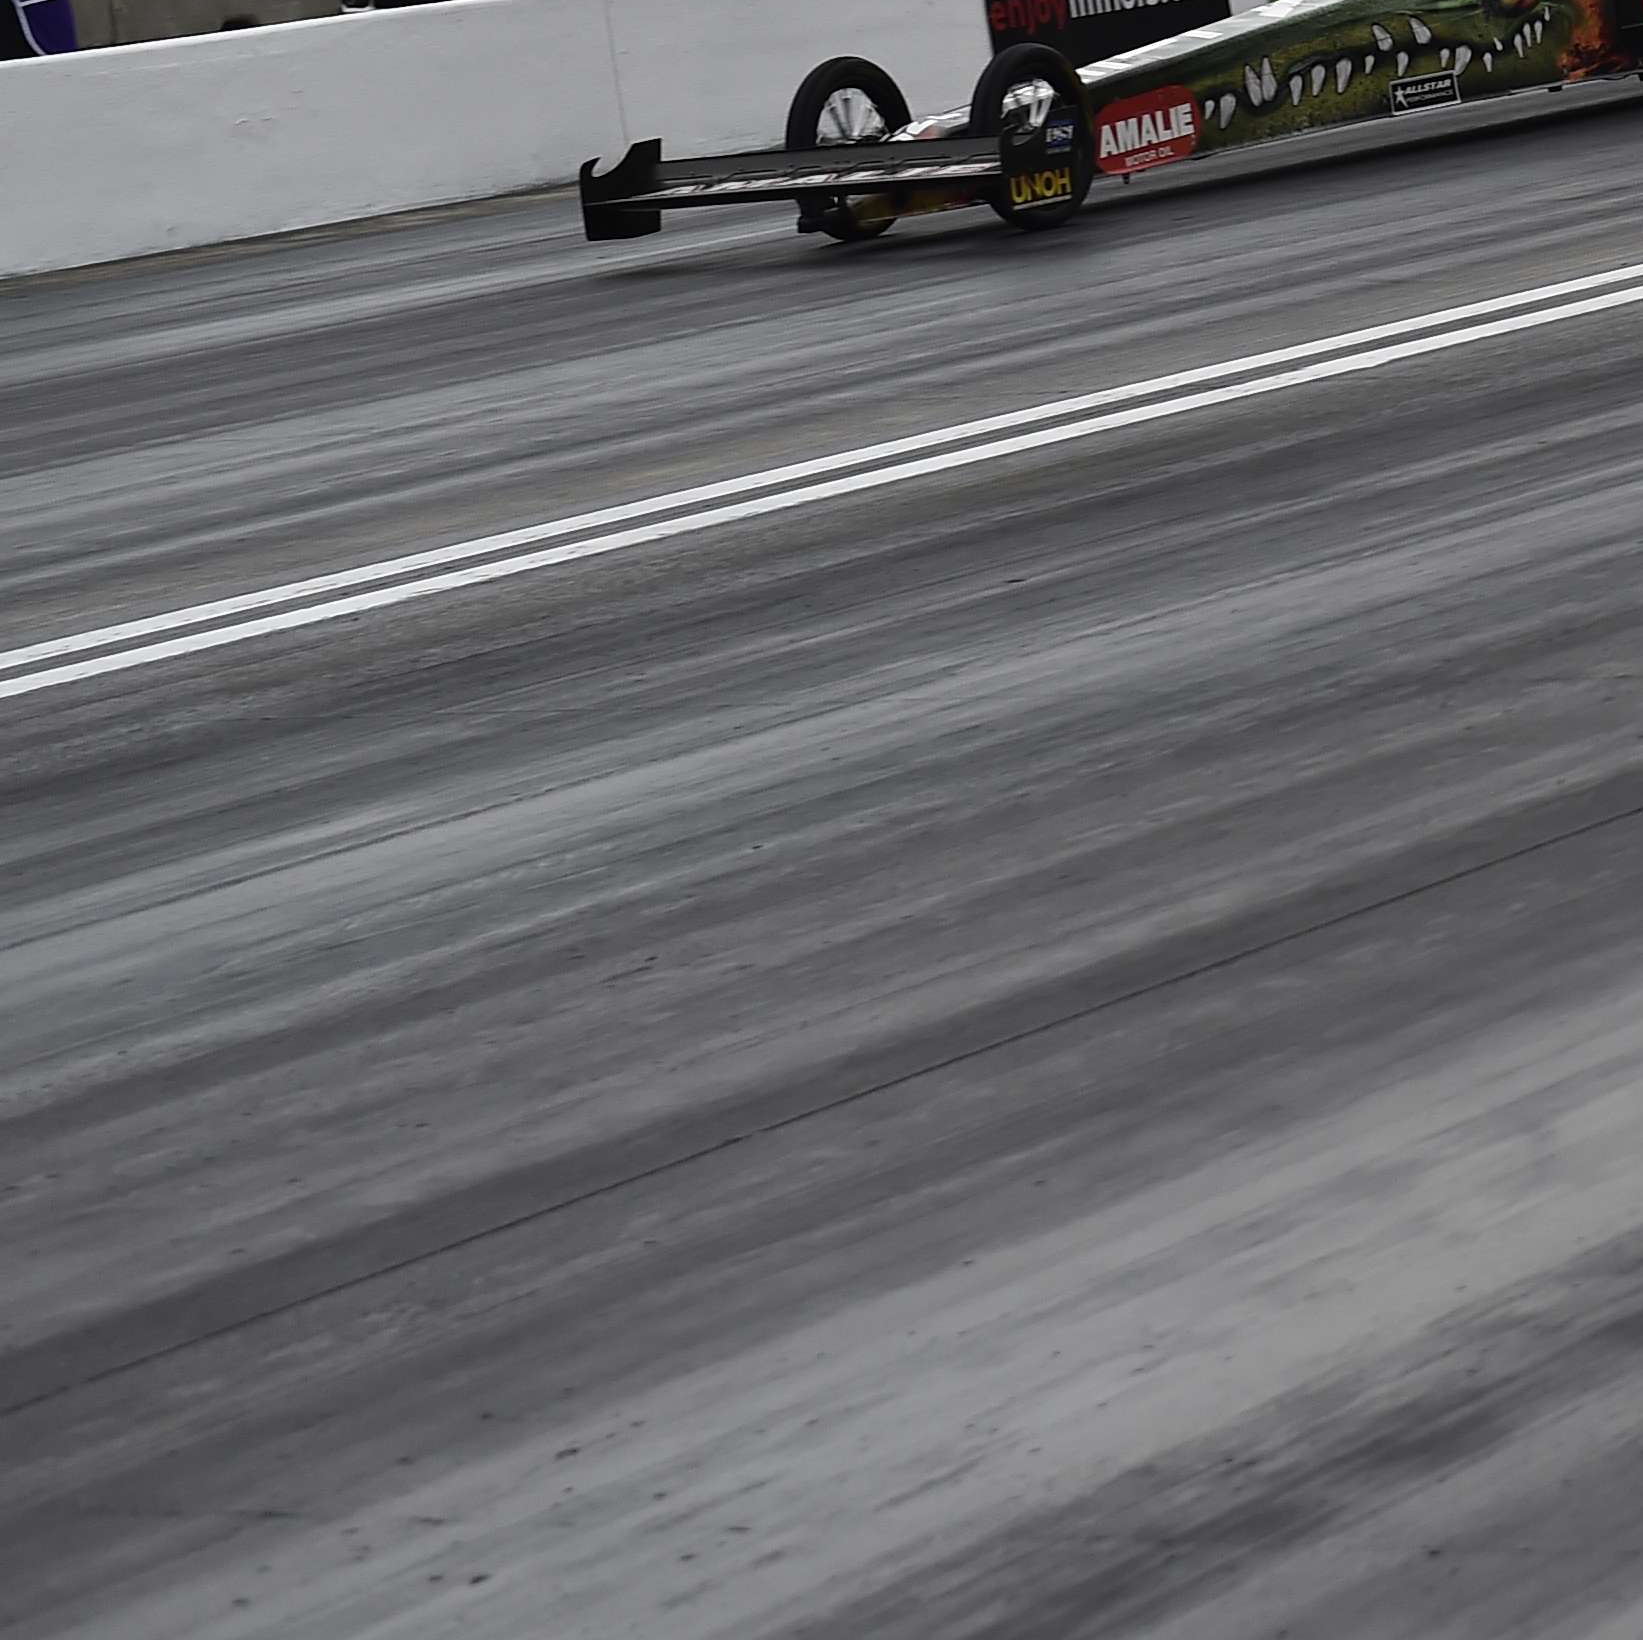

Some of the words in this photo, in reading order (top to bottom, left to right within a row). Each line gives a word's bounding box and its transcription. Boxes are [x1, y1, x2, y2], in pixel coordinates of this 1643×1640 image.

[1100, 103, 1195, 159] AMALIE
[1159, 146, 1175, 158] OIL
[1010, 168, 1072, 204] UNOH
